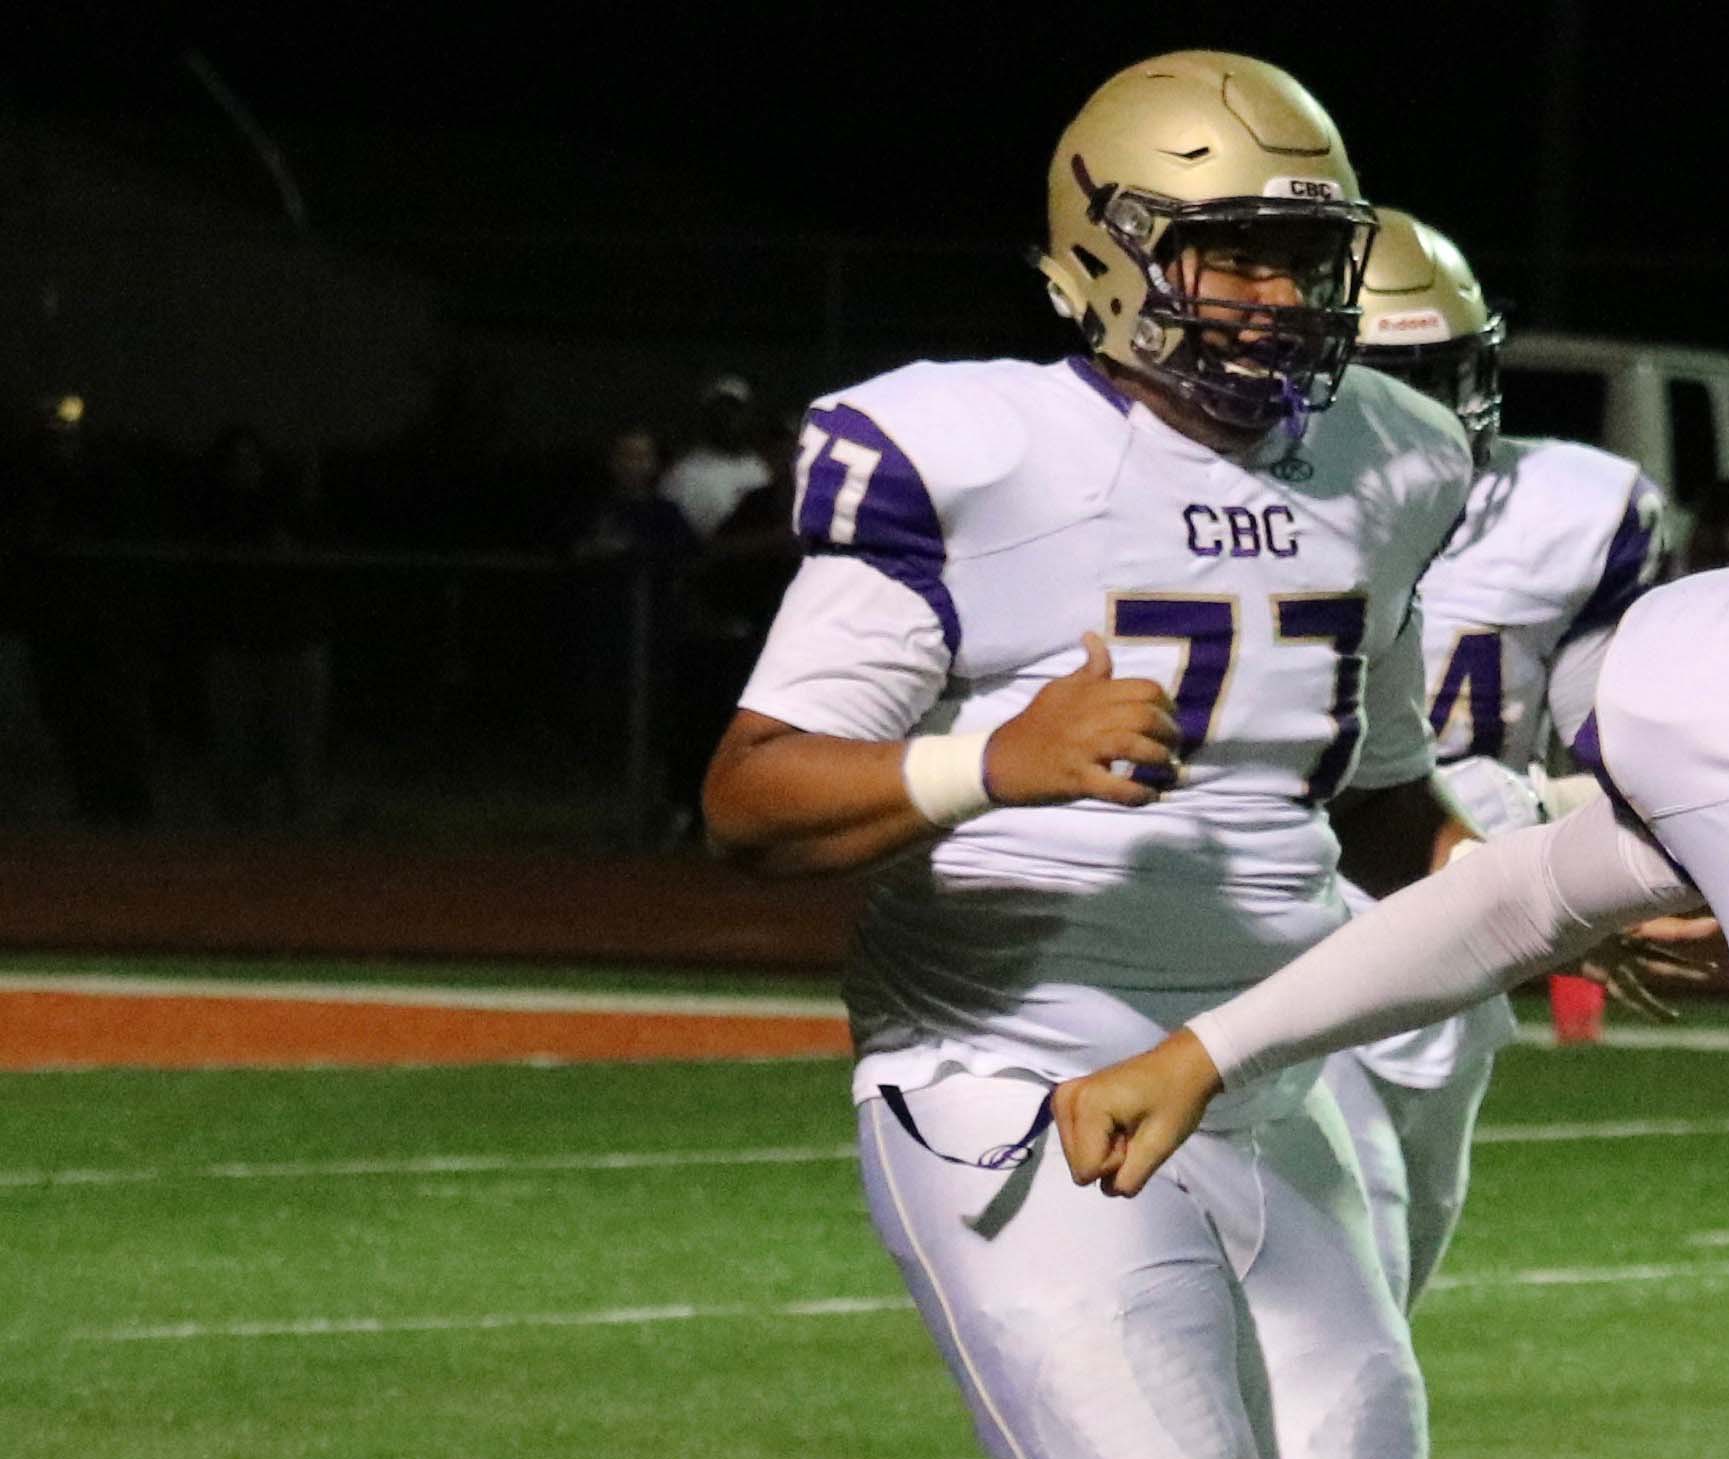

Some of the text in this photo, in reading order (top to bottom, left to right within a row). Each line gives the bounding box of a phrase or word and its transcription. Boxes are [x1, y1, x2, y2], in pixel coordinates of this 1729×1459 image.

[1289, 179, 1332, 200] CBC
[1182, 502, 1300, 558] CBC
[1104, 590, 1370, 806] 77
